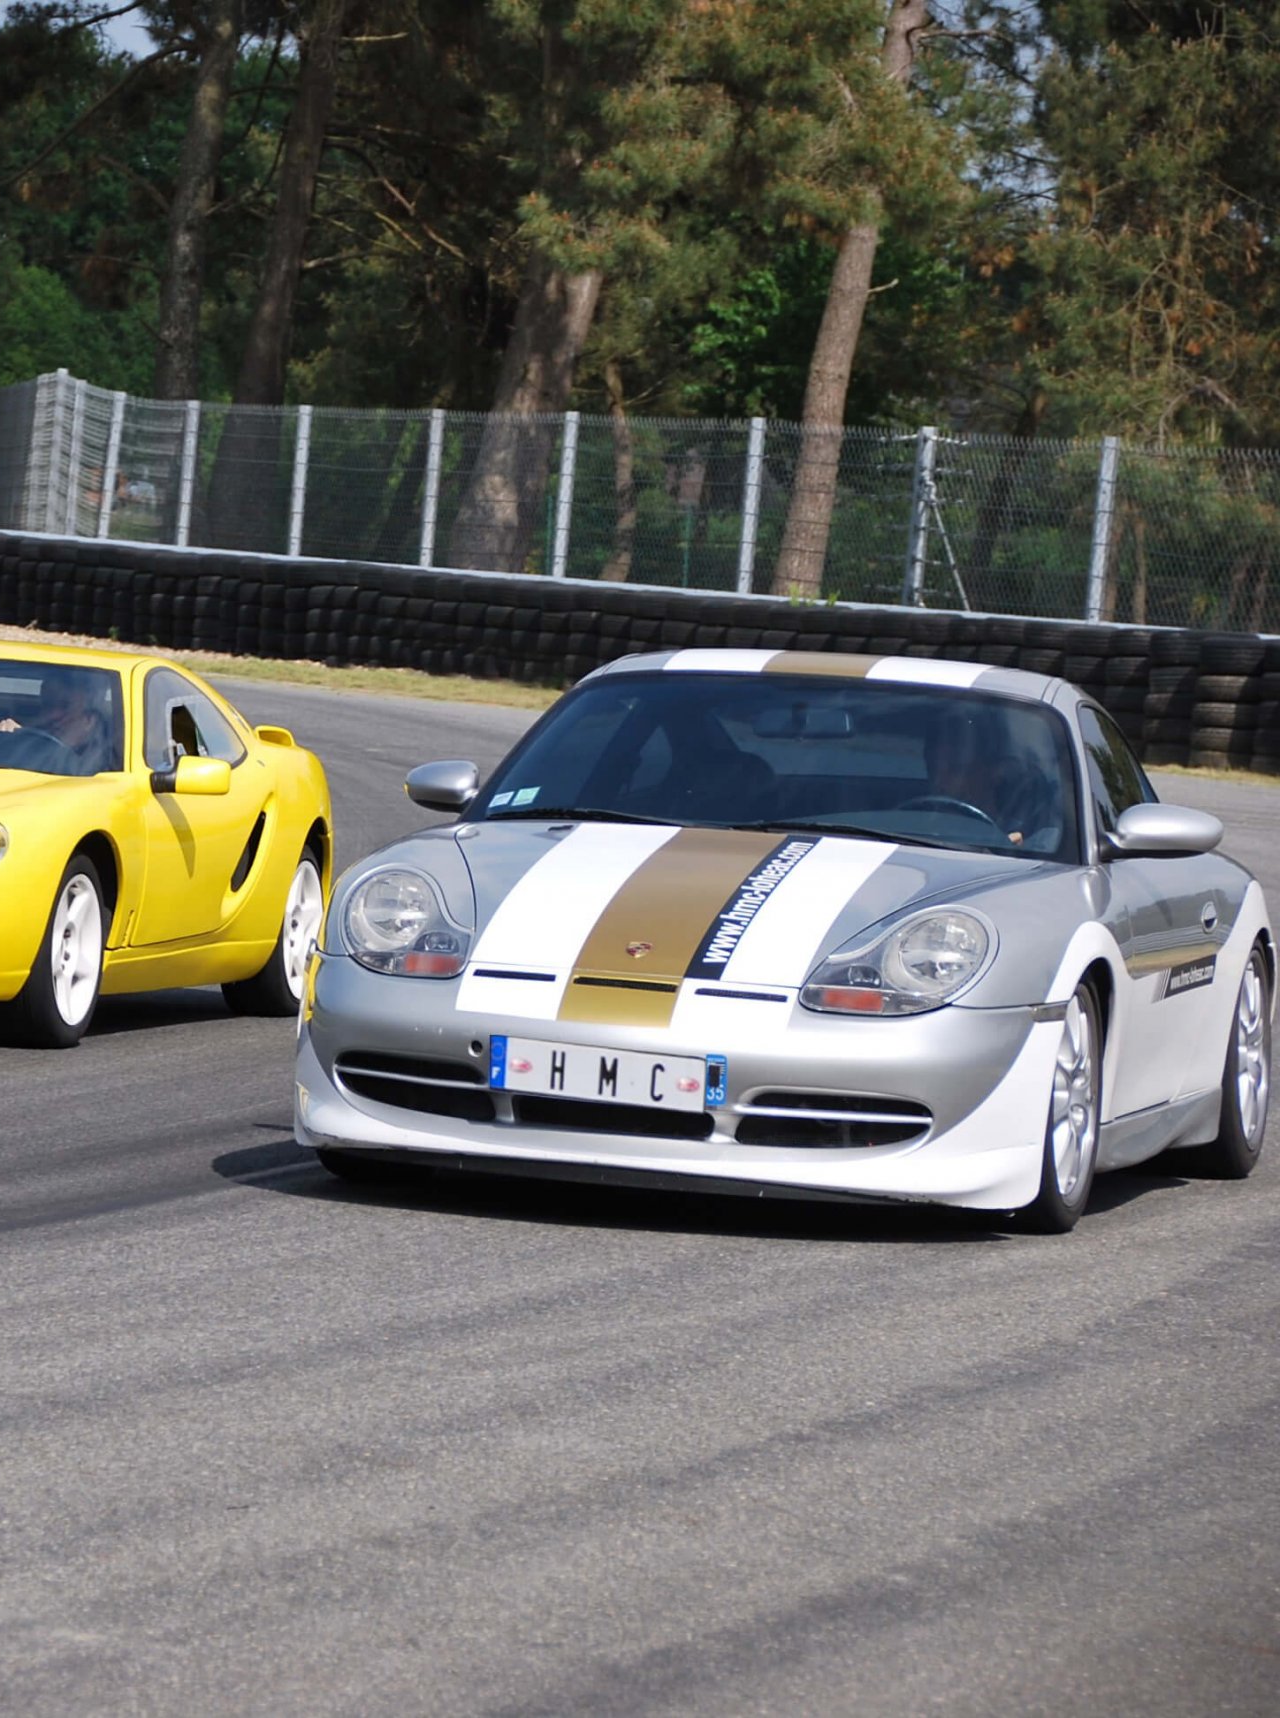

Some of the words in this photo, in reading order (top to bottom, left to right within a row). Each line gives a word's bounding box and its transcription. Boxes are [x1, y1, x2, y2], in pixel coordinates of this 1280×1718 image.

[702, 841, 814, 963] www.hmc-loheac.com
[550, 1050, 566, 1091] H
[598, 1056, 618, 1097] M
[650, 1063, 666, 1102] C
